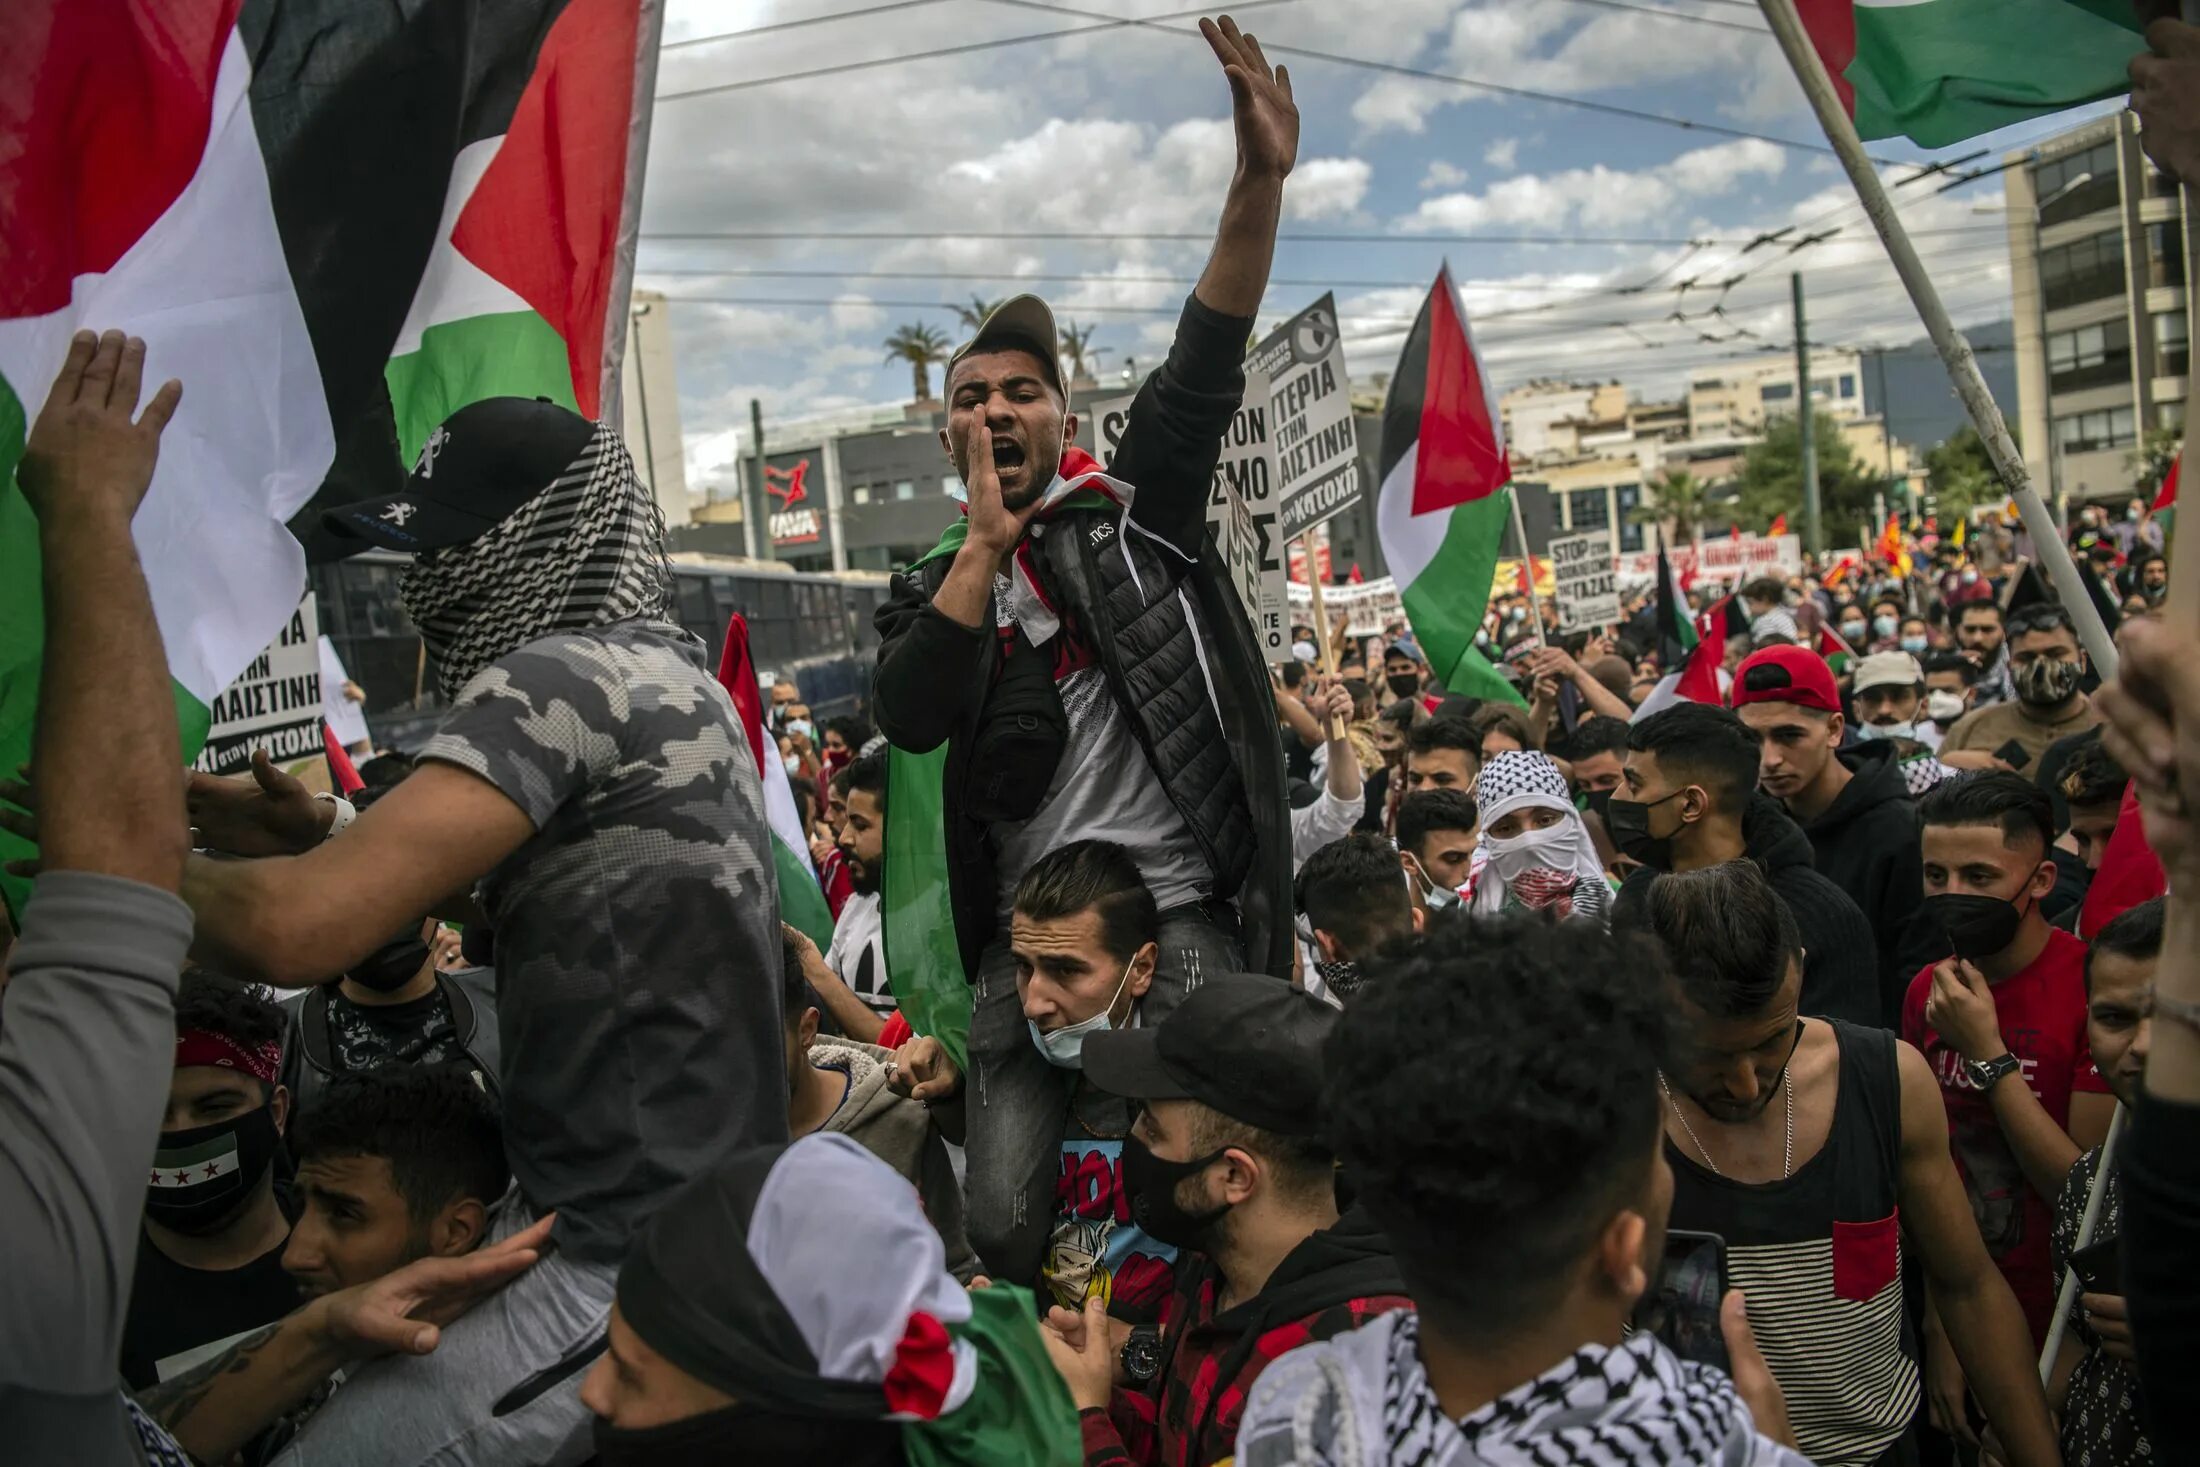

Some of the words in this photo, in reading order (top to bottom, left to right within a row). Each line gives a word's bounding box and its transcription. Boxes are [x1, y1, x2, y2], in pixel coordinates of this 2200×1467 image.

[1275, 413, 1308, 454] ΣΤΗΝ
[1279, 415, 1354, 491] ΑΙΣΤΙΝΗ
[1553, 539, 1588, 563] STOP
